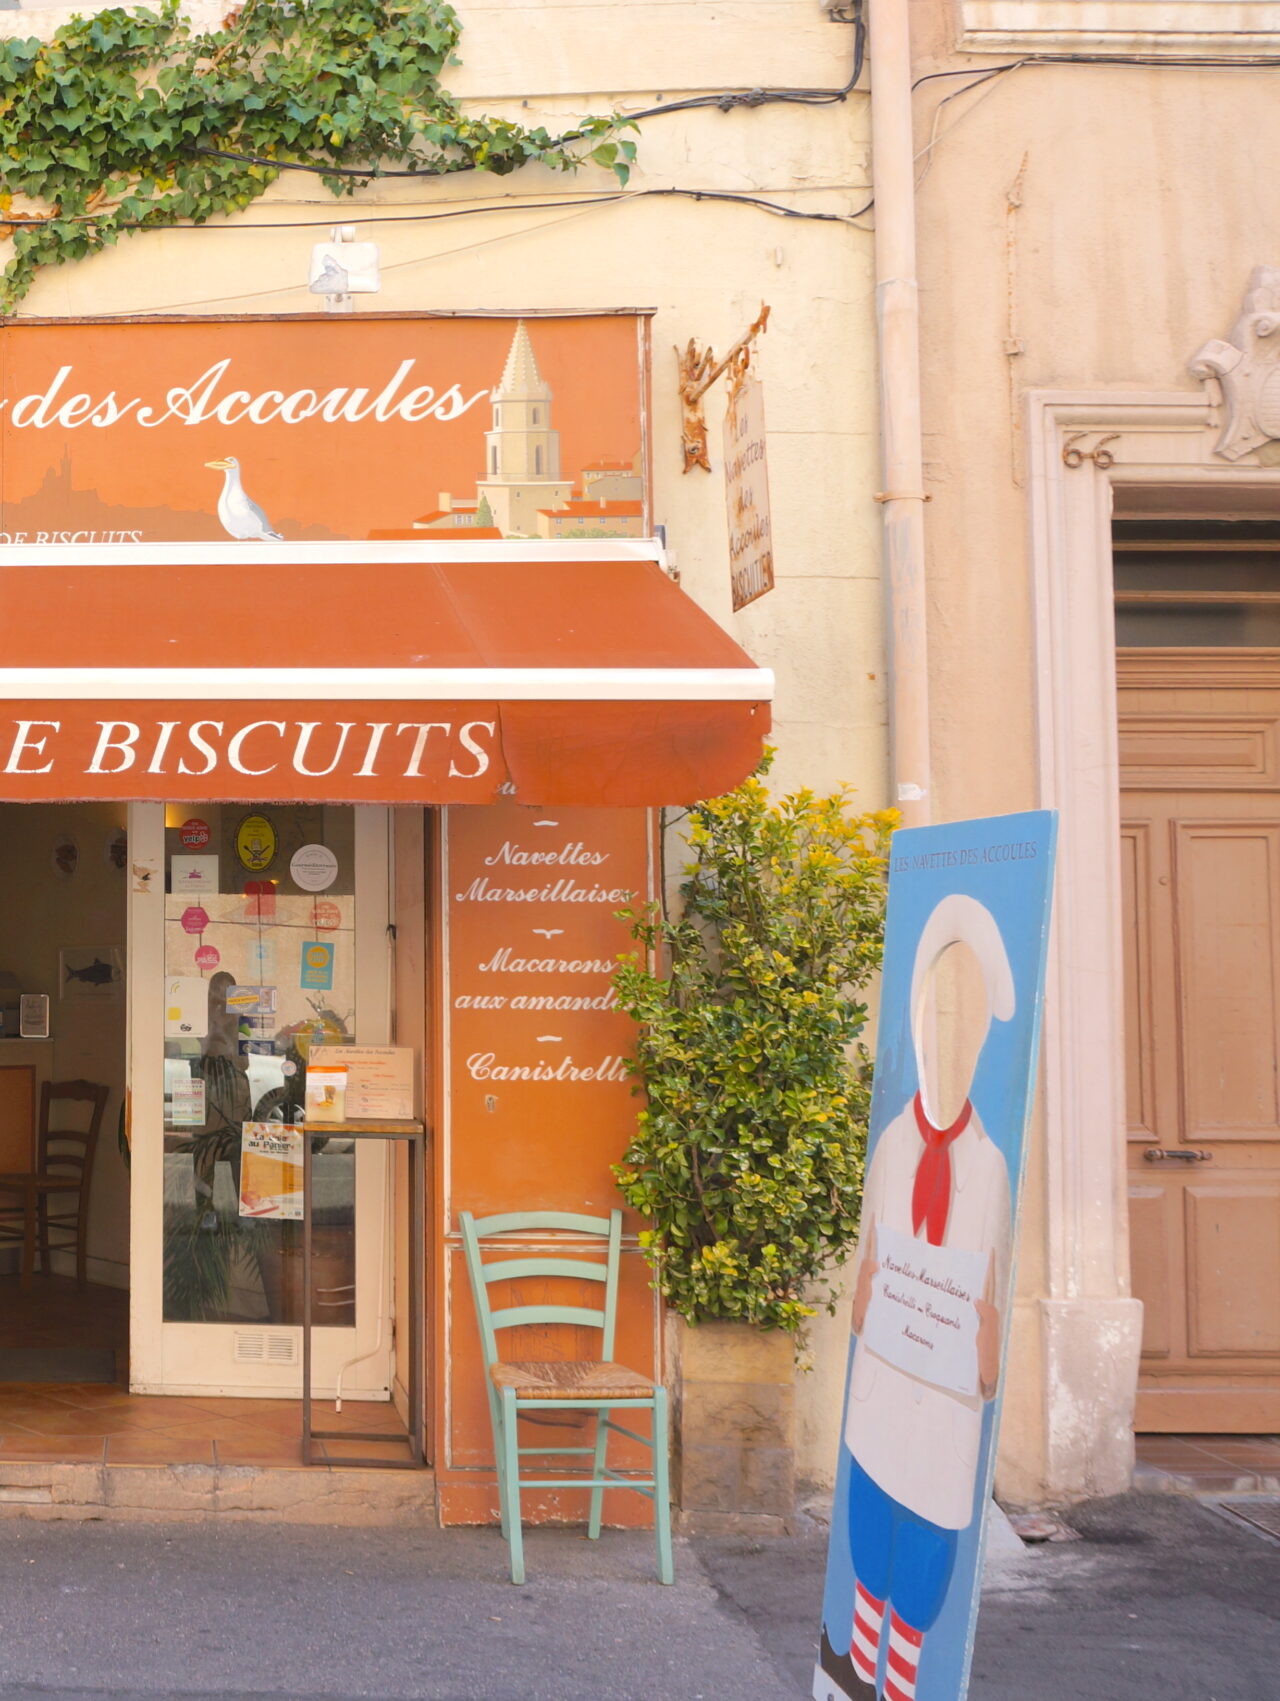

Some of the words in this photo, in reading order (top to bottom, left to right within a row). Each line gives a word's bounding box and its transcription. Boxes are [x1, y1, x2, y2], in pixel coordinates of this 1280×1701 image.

[11, 365, 141, 430] des
[137, 358, 489, 426] Accoules
[1062, 432, 1121, 470] 66
[35, 530, 143, 544] BISCUITS
[84, 720, 497, 779] BISCUITS
[484, 841, 610, 866] Navettes
[894, 856, 909, 872] LES
[912, 851, 958, 870] NAVETTES
[960, 847, 979, 866] DES
[982, 841, 1038, 863] ACCOULES
[455, 877, 638, 903] Marseillaises
[478, 948, 618, 973] Macarons
[455, 994, 508, 1010] aux
[510, 987, 634, 1011] amand
[466, 1053, 629, 1082] Canistrelli
